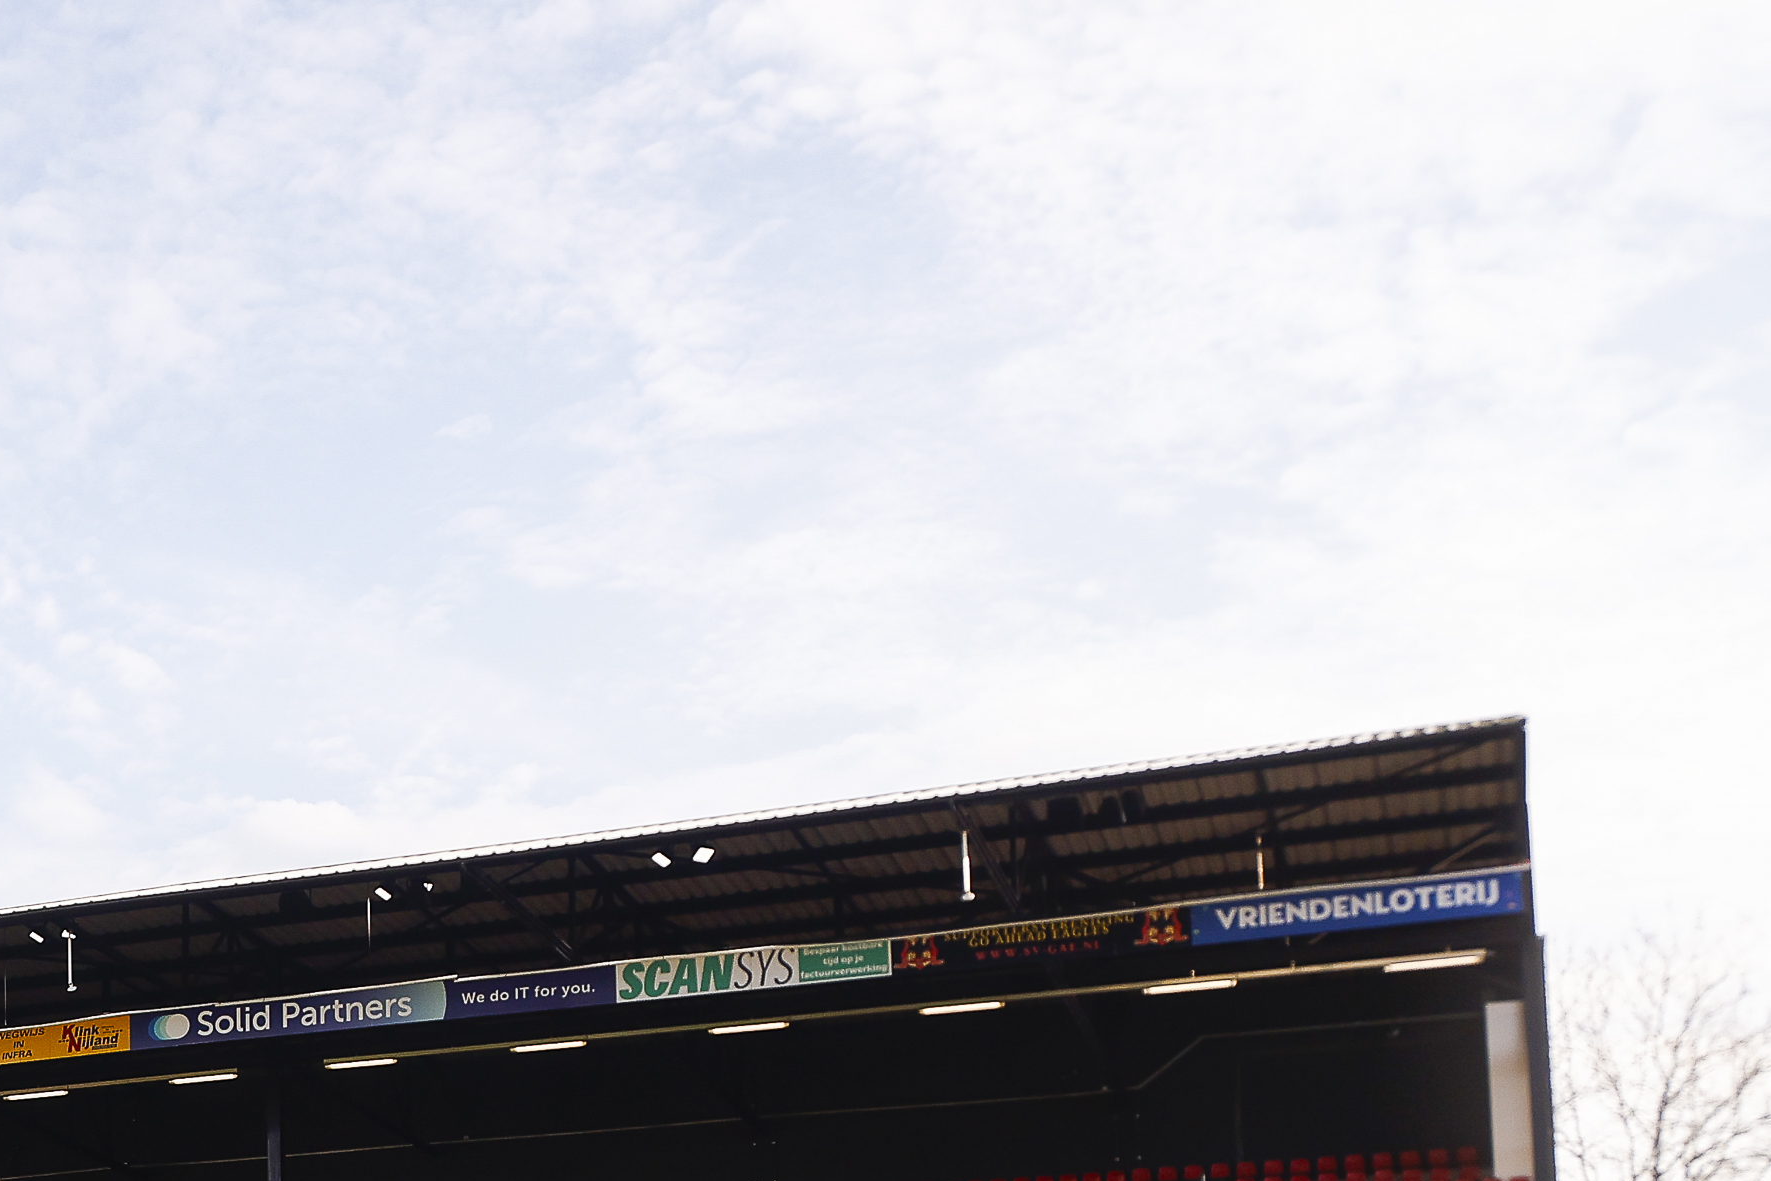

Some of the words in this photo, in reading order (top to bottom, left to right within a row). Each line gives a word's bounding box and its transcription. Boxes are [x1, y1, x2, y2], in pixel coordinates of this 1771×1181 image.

[1216, 879, 1500, 930] VRIENDENLOTERIJ
[968, 936, 990, 948] GO
[841, 956, 854, 965] op
[854, 954, 865, 964] je
[619, 948, 796, 1000] SCANSYS
[461, 991, 486, 1005] We
[490, 988, 510, 1003] do
[515, 987, 529, 1001] IT
[534, 985, 556, 999] for
[561, 983, 595, 999] you.
[197, 1005, 270, 1037] Solid
[282, 996, 412, 1027] Partners
[62, 1024, 100, 1040] Klink
[13, 1040, 25, 1048] IN
[2, 1050, 33, 1060] INFRA
